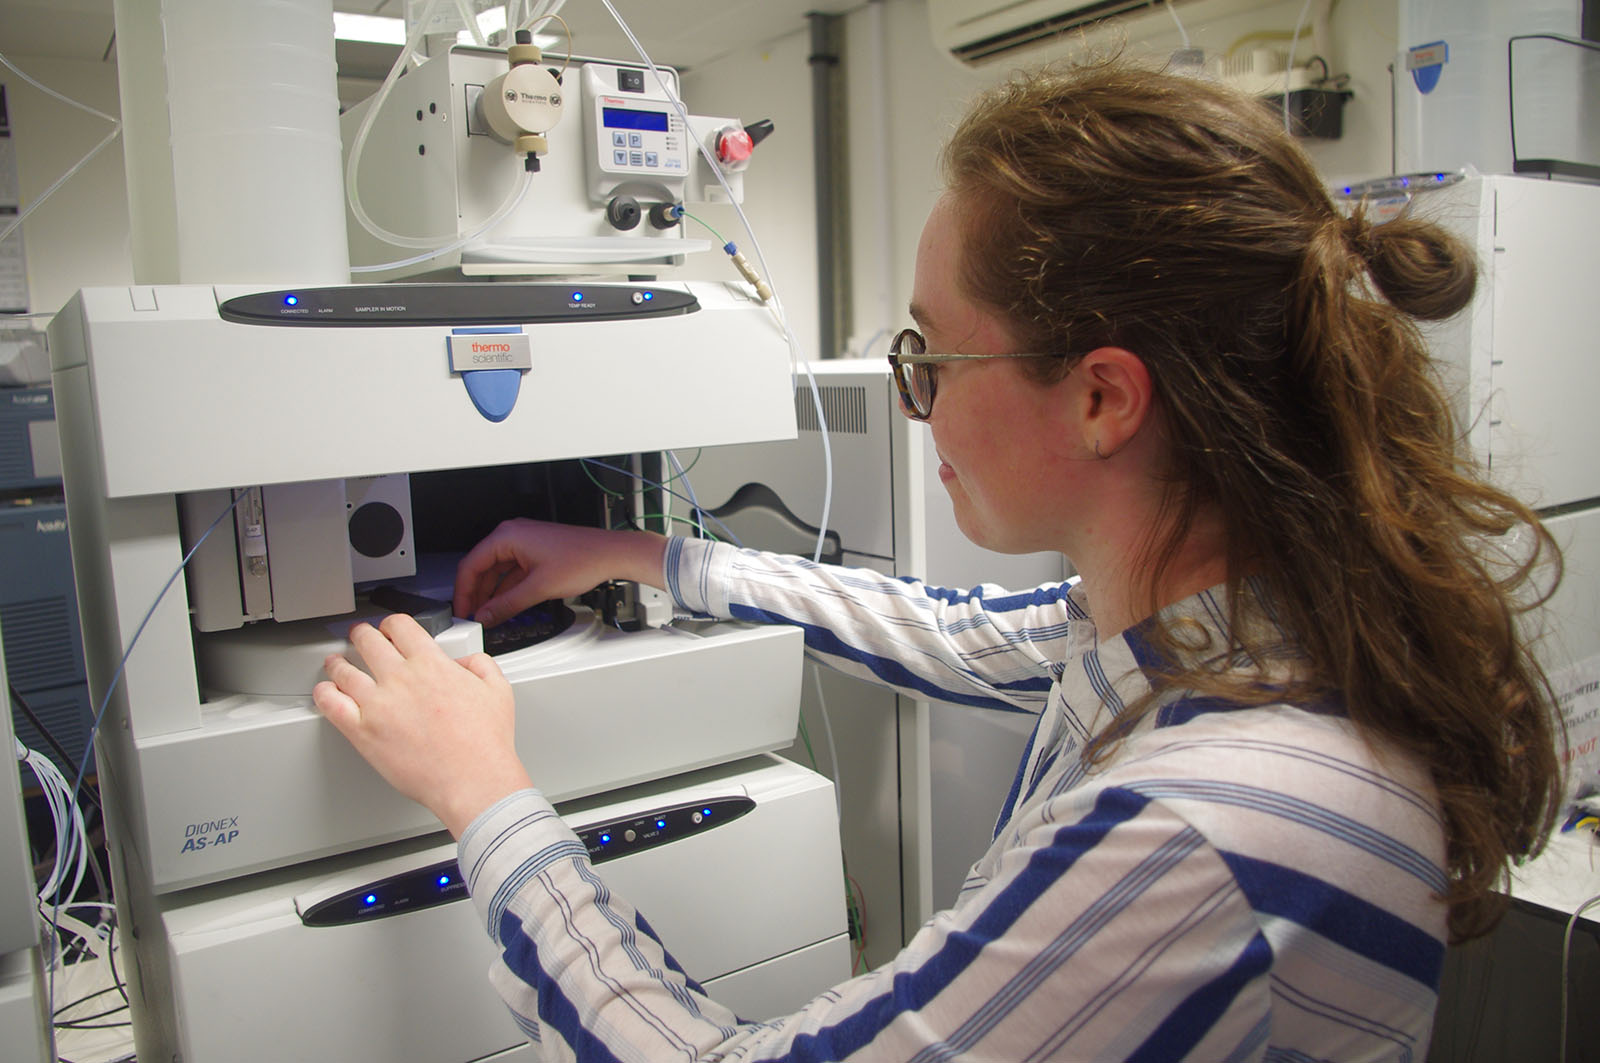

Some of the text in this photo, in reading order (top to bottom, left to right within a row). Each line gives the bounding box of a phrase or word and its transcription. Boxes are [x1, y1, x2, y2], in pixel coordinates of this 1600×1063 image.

[520, 92, 548, 101] Thermo
[472, 342, 510, 352] thermo
[472, 353, 512, 364] scientific
[185, 815, 239, 838] DIONEX
[180, 830, 240, 854] AS-AP
